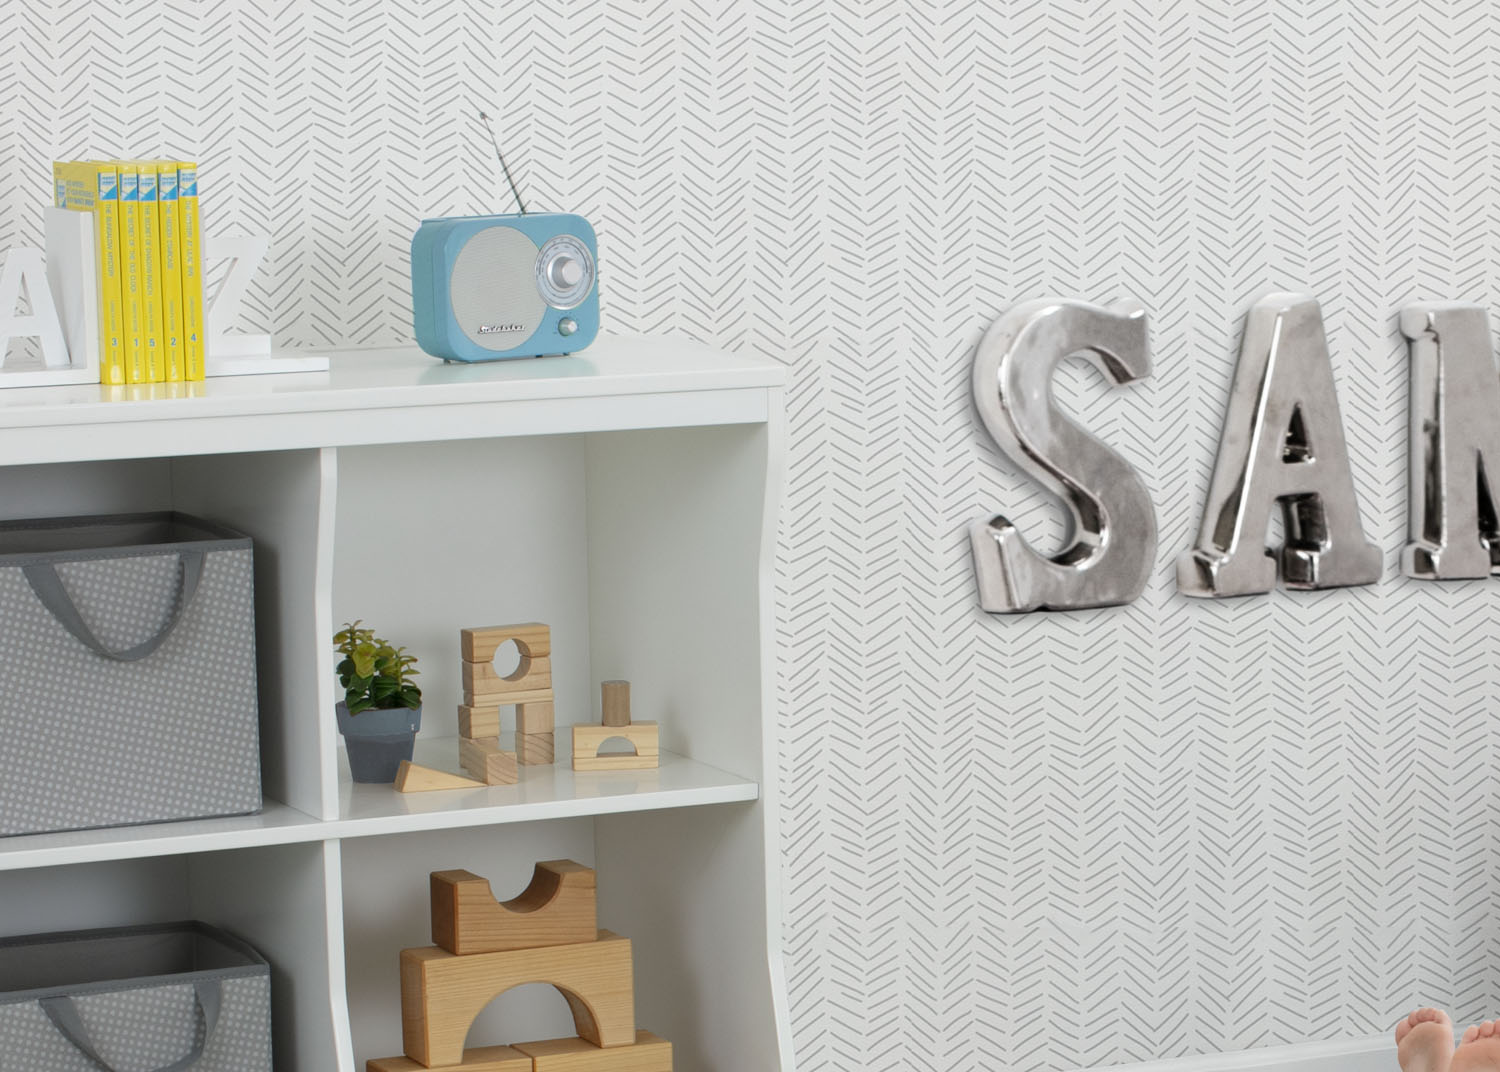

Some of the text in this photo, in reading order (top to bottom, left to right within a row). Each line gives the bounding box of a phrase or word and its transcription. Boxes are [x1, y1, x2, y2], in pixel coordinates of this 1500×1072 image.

[111, 337, 118, 348] 3
[133, 337, 139, 348] 1
[149, 337, 156, 348] 5
[170, 337, 177, 347] 2
[190, 333, 197, 343] 4
